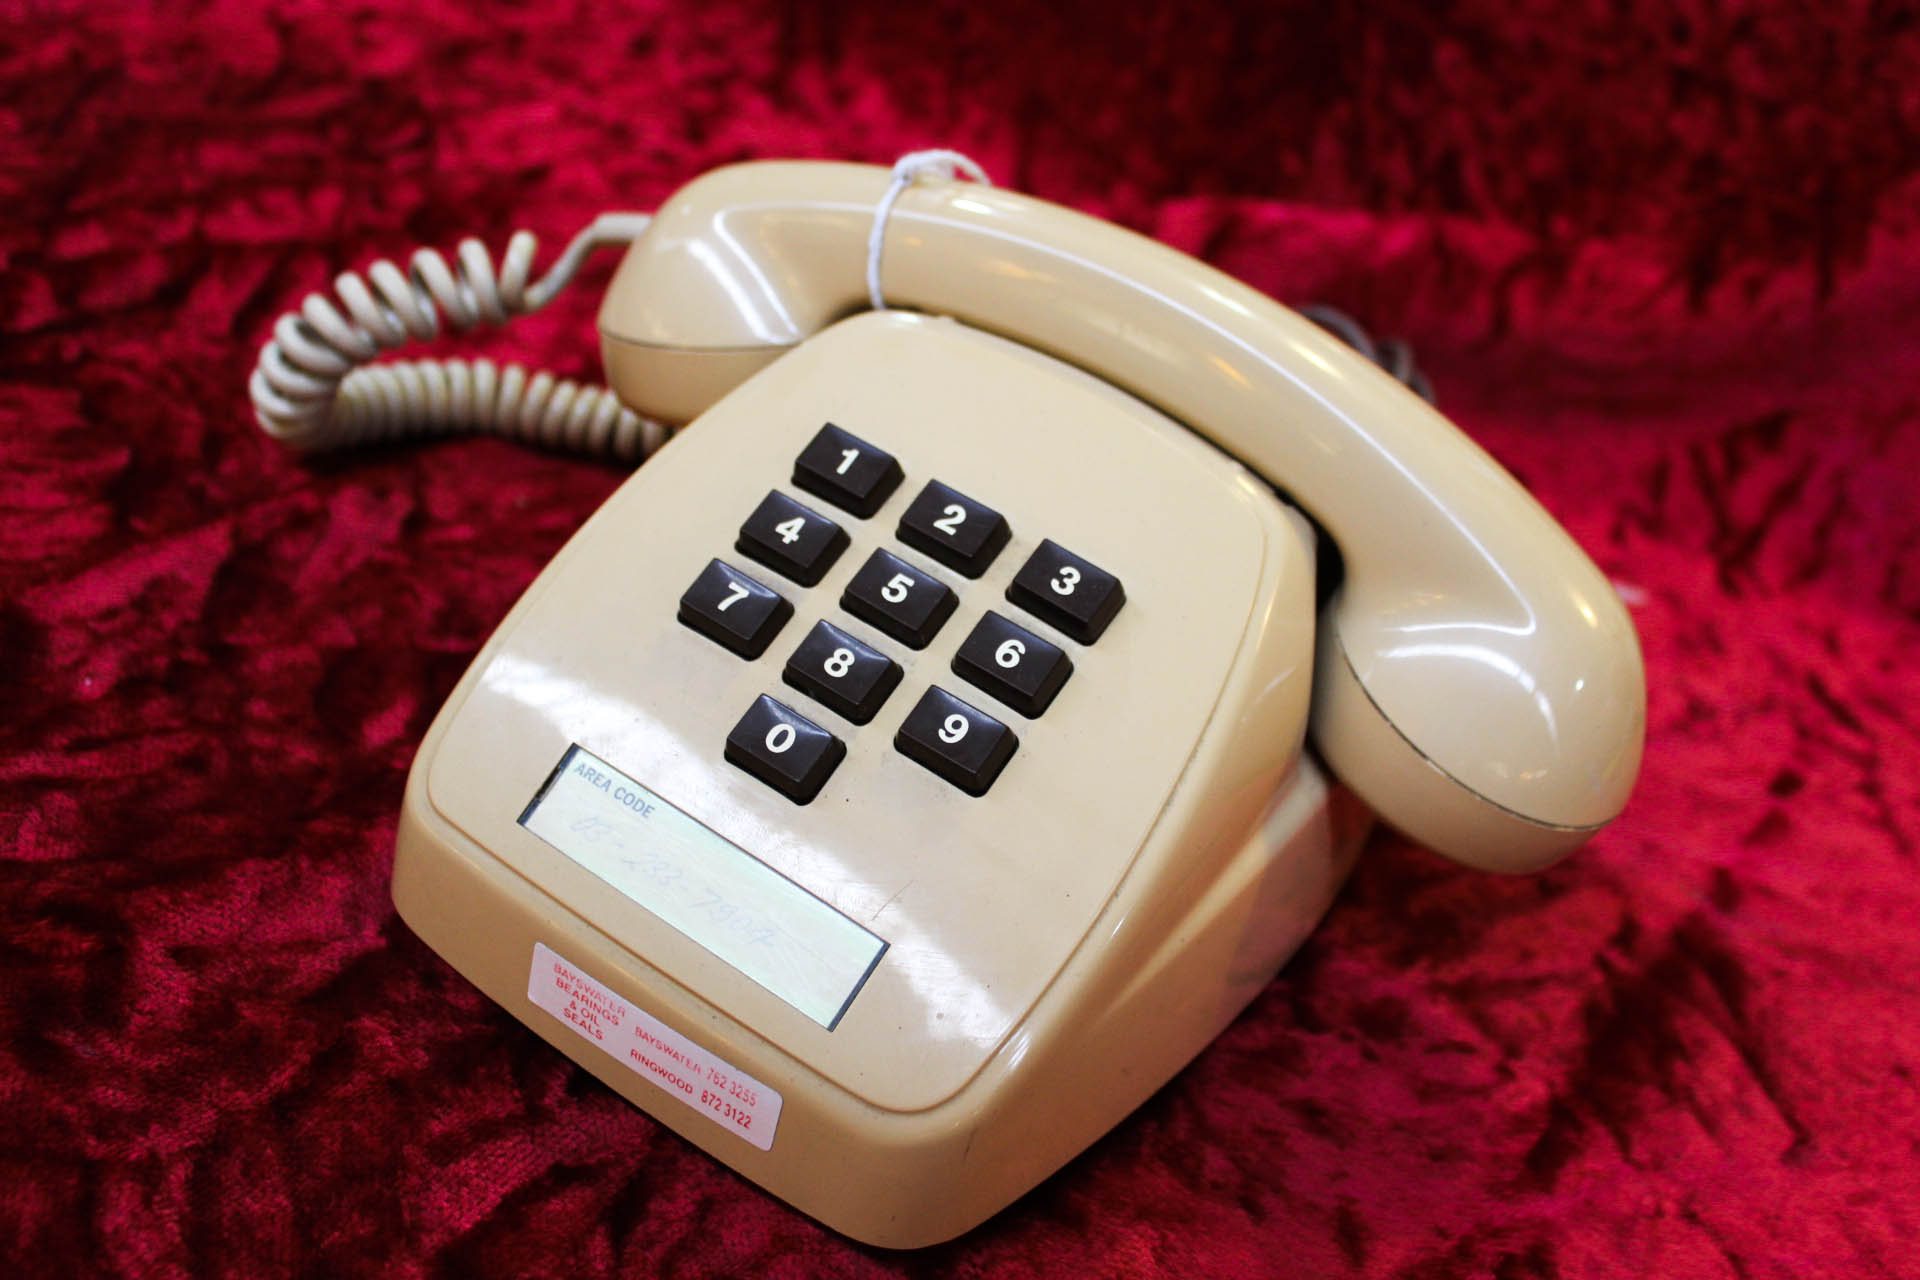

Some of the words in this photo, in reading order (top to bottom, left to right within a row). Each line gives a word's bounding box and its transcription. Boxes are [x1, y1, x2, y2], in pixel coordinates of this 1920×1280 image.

[835, 448, 860, 475] 1
[933, 504, 967, 536] 2
[1050, 566, 1081, 596] 3
[775, 516, 806, 545] 4
[881, 572, 915, 603] 5
[995, 639, 1026, 669] 6
[716, 581, 750, 612] 7
[823, 647, 856, 678] 8
[938, 713, 970, 744] 9
[765, 723, 797, 754] 0
[574, 763, 612, 793] AREA
[614, 787, 655, 819] CODE
[554, 963, 626, 1018] BAYSWATER
[556, 976, 619, 1026] BEARINGS
[581, 1007, 600, 1027] OIL
[563, 1007, 603, 1040] SEALS
[630, 1048, 693, 1094] RINGWOOD
[701, 1090, 723, 1112] 872
[724, 1103, 752, 1129] 3122
[635, 1026, 702, 1075] BAYSWATER
[706, 1067, 728, 1089] 762
[729, 1081, 758, 1107] 3255
